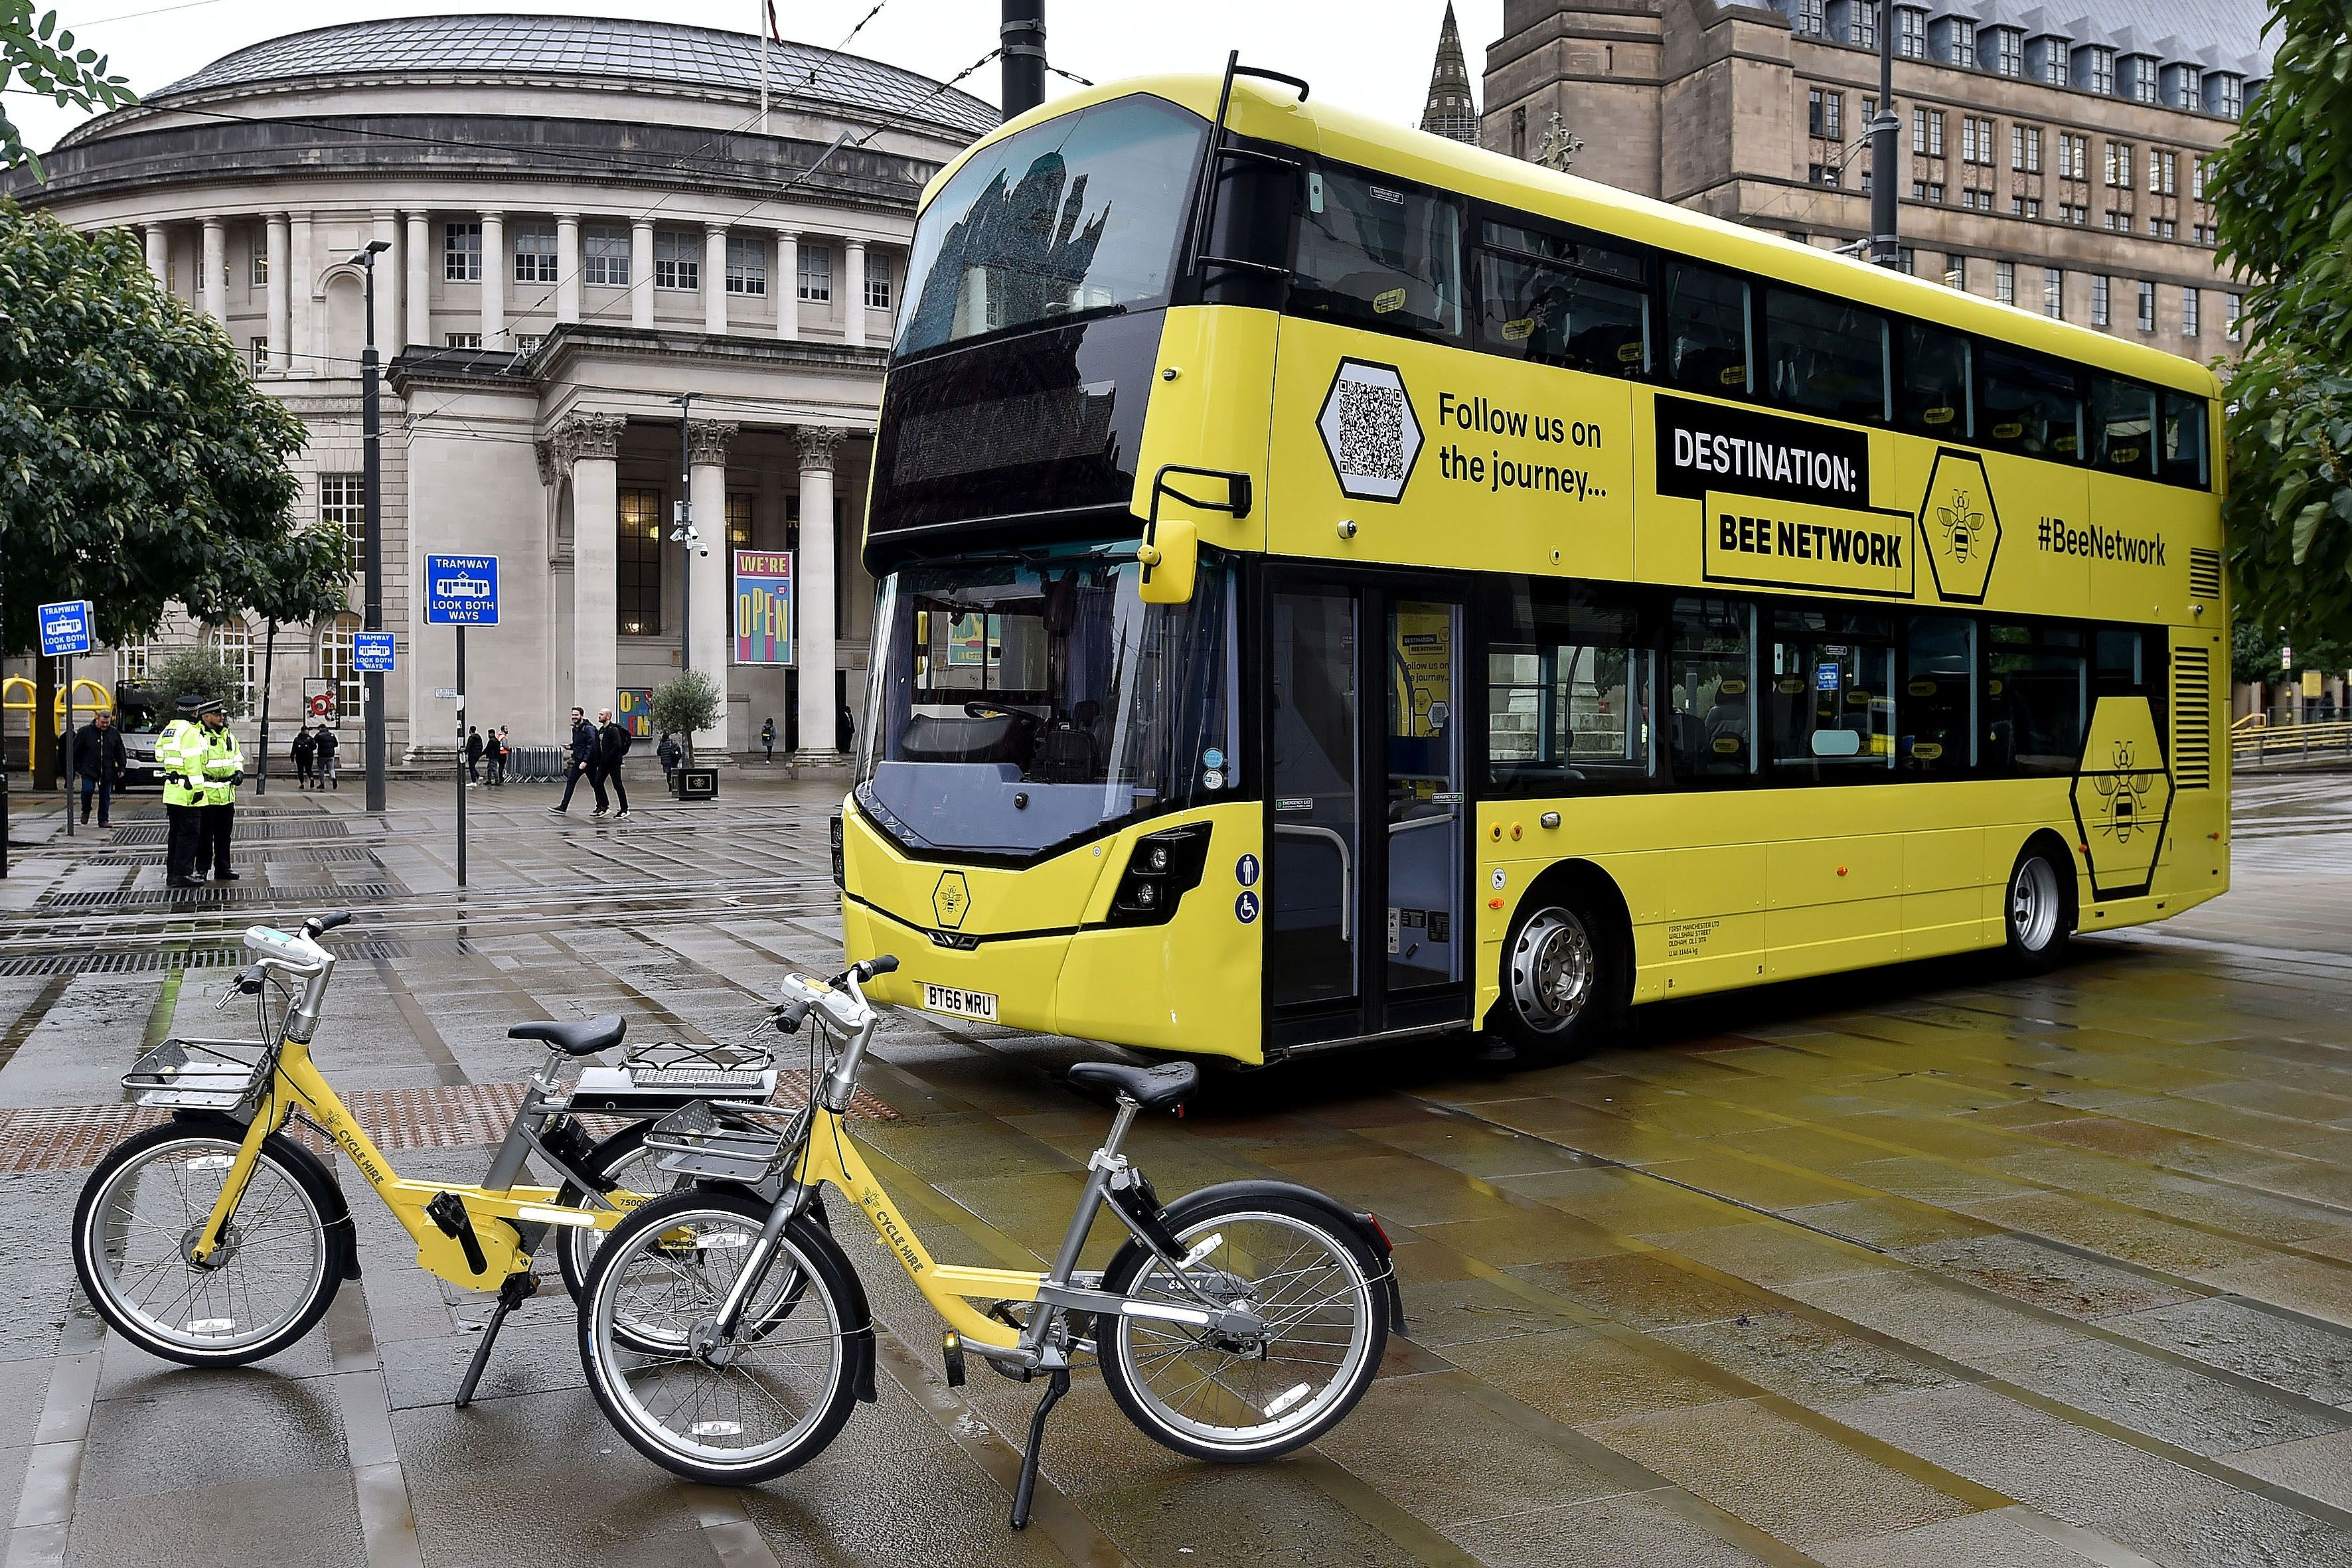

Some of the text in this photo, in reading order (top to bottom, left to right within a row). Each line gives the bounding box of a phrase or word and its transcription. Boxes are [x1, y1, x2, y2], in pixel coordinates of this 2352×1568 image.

[1439, 392, 1601, 449] Follow us on
[1675, 428, 1856, 493] DESTINATION:
[1439, 444, 1607, 502] the journey...
[1719, 513, 1903, 568] BEE NETWORK
[2038, 516, 2166, 566] #BeeNetwork
[435, 559, 489, 569] TRAMWAY
[740, 556, 787, 573] WE'RE
[44, 605, 80, 615] TRAMWAY
[433, 600, 494, 610] LOOK BOTH
[449, 611, 479, 620] WAYS
[739, 588, 788, 642] OPEN
[44, 634, 86, 645] LOOK BOTH
[56, 642, 76, 651] WAYS
[1682, 921, 1711, 930] MANCHESTER
[1668, 939, 1687, 947] OLDHAM
[929, 986, 990, 1015] BT66 MRU
[339, 1129, 385, 1185] CYCLE HIRE
[876, 1211, 924, 1273] CYCLE HIRE
